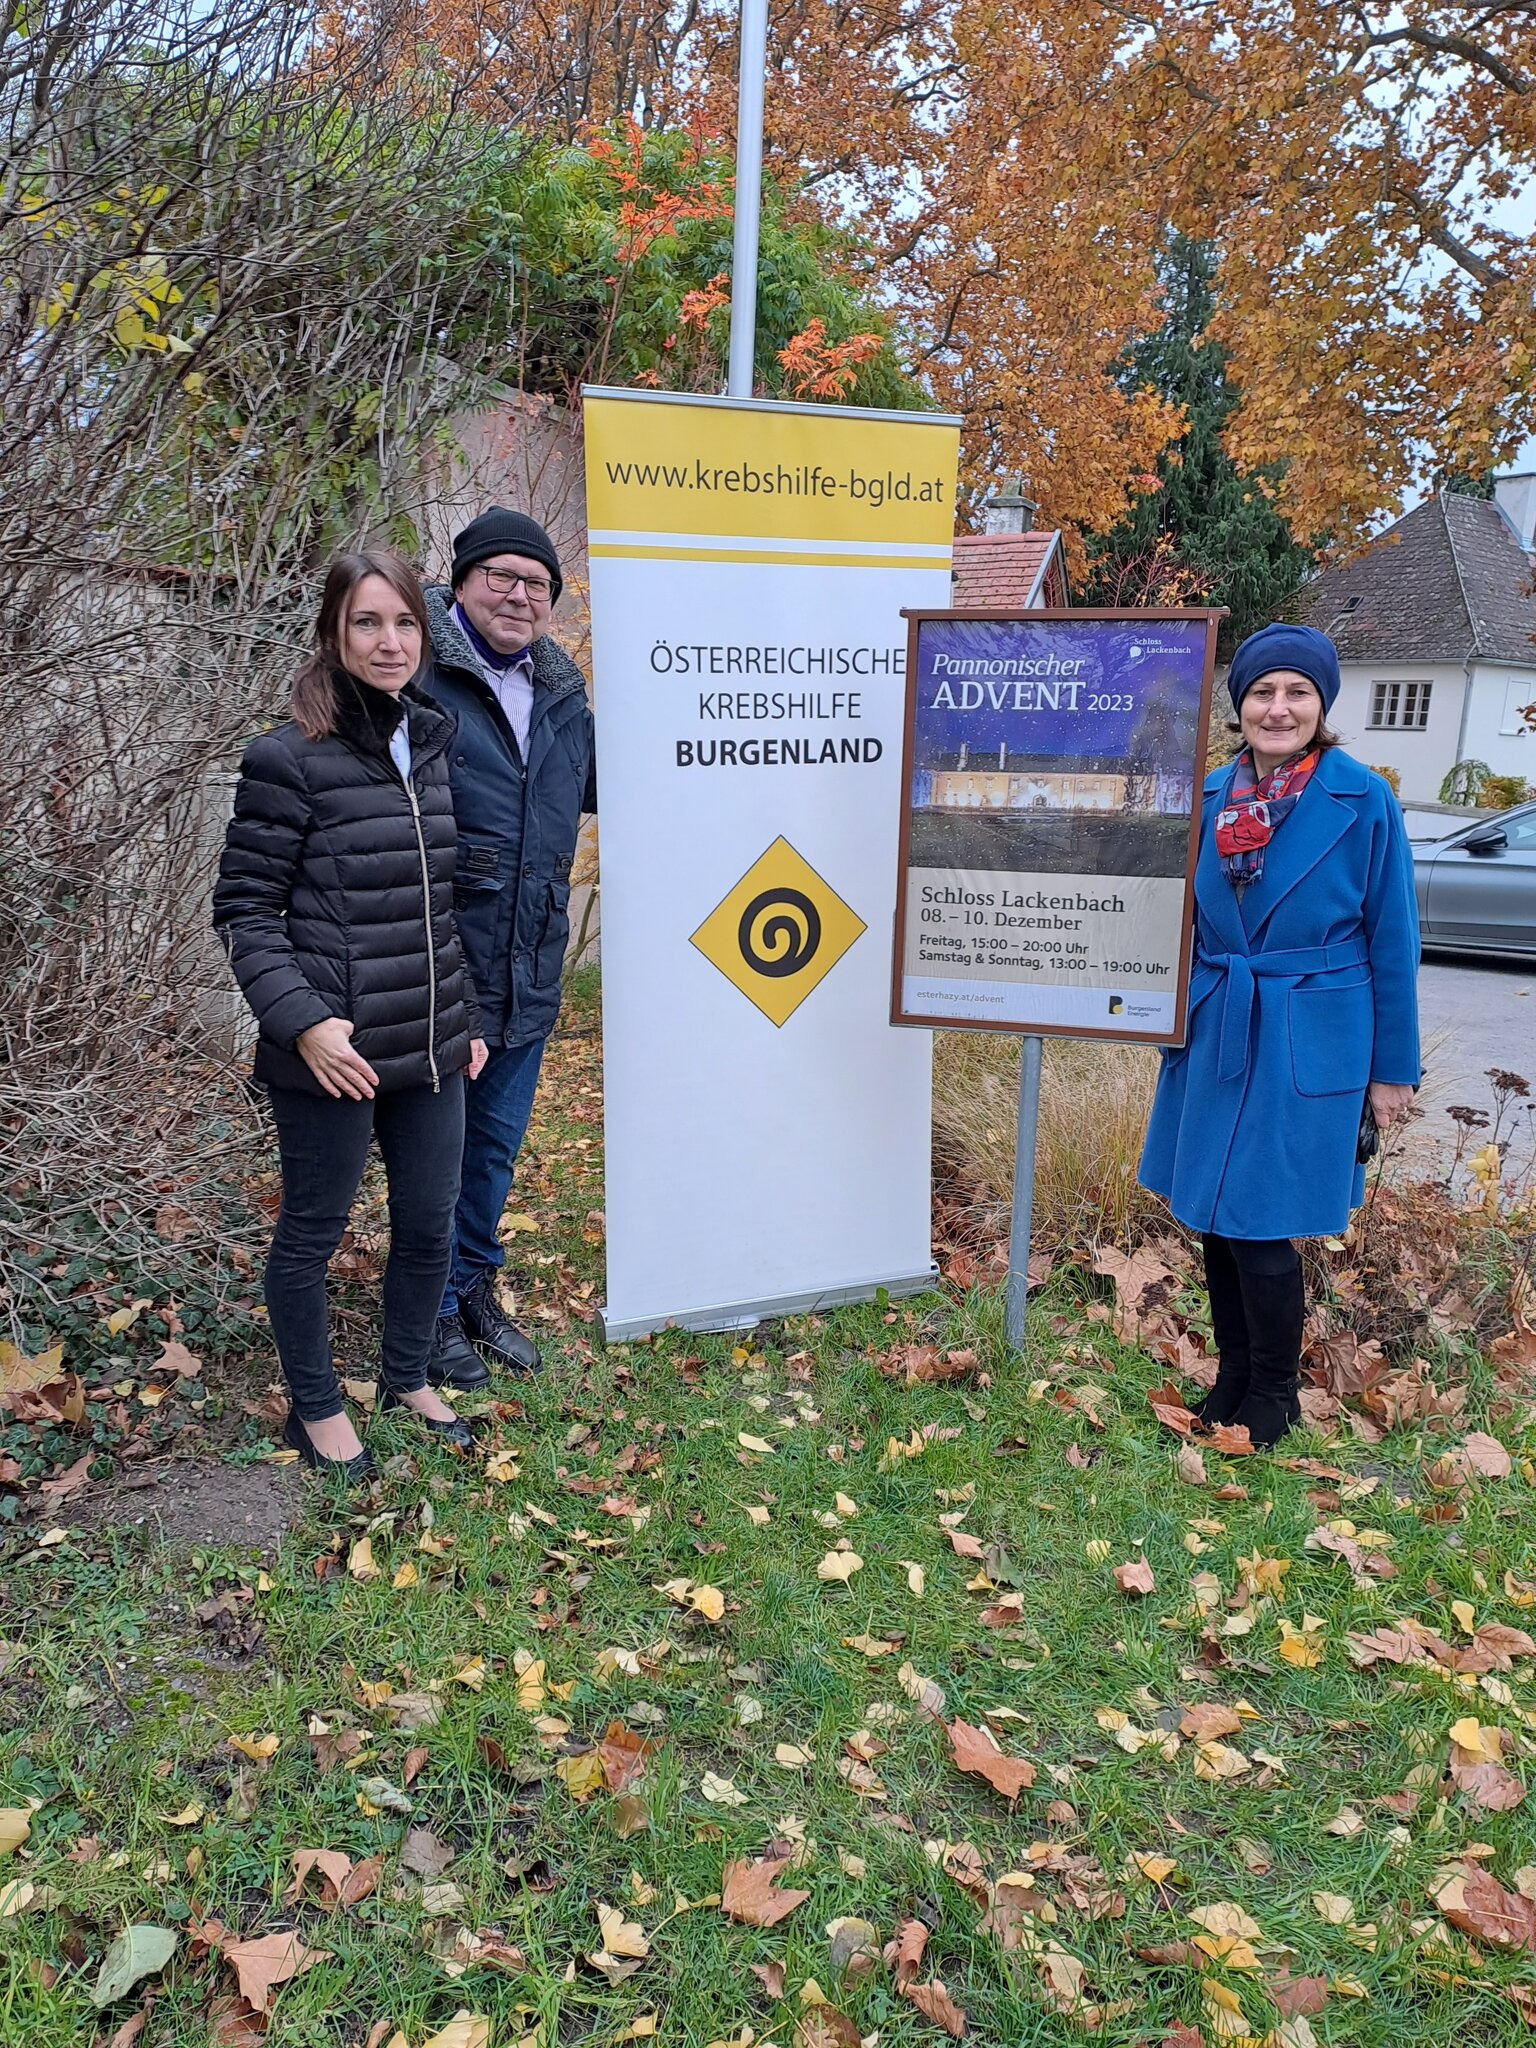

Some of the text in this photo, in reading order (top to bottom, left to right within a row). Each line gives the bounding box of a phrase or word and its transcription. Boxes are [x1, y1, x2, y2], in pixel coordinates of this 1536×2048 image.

[606, 459, 944, 507] www.krebshilfe-bgld.at
[650, 640, 906, 675] ÖSTERREICHISCHE
[1146, 646, 1191, 654] Lackenbach
[930, 653, 1086, 677] Pannonischer
[699, 692, 862, 720] KREBSHILFE
[931, 682, 1133, 711] ADVENT 2023
[676, 738, 883, 767] BURGENLAND
[921, 886, 1126, 913] Schloss Lackenbach
[994, 912, 1083, 931] Dezember
[919, 934, 966, 950] Freitag,
[971, 938, 1008, 950] 15:00
[1022, 941, 1062, 953] 20:00
[1065, 942, 1089, 954] Uhr
[919, 950, 971, 966] Samstag
[975, 953, 985, 964] &
[988, 954, 1044, 970] Sonntag,
[1049, 958, 1086, 970] 13:00
[1103, 960, 1142, 974] 19:00
[1146, 963, 1170, 975] Uhr
[917, 990, 1004, 1004] esterhazy.at/advent
